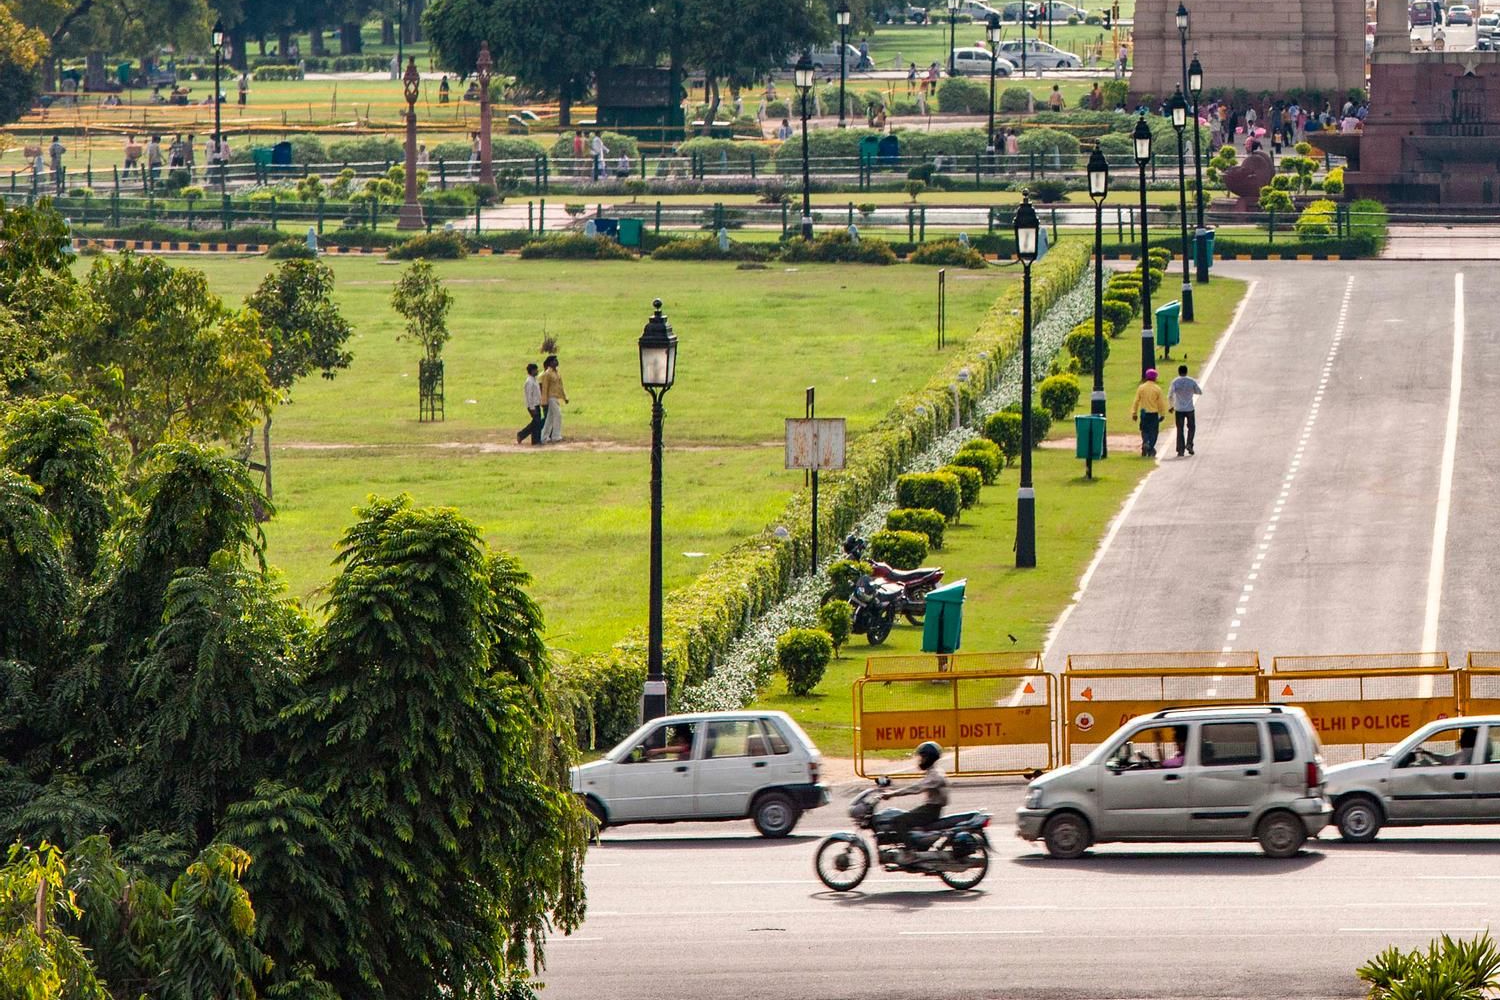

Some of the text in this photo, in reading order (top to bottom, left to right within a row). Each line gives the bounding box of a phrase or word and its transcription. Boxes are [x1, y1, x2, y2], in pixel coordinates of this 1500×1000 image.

[876, 722, 1006, 741] NEW DELHI DISTT.
[1312, 714, 1410, 732] ELHI POLICE
